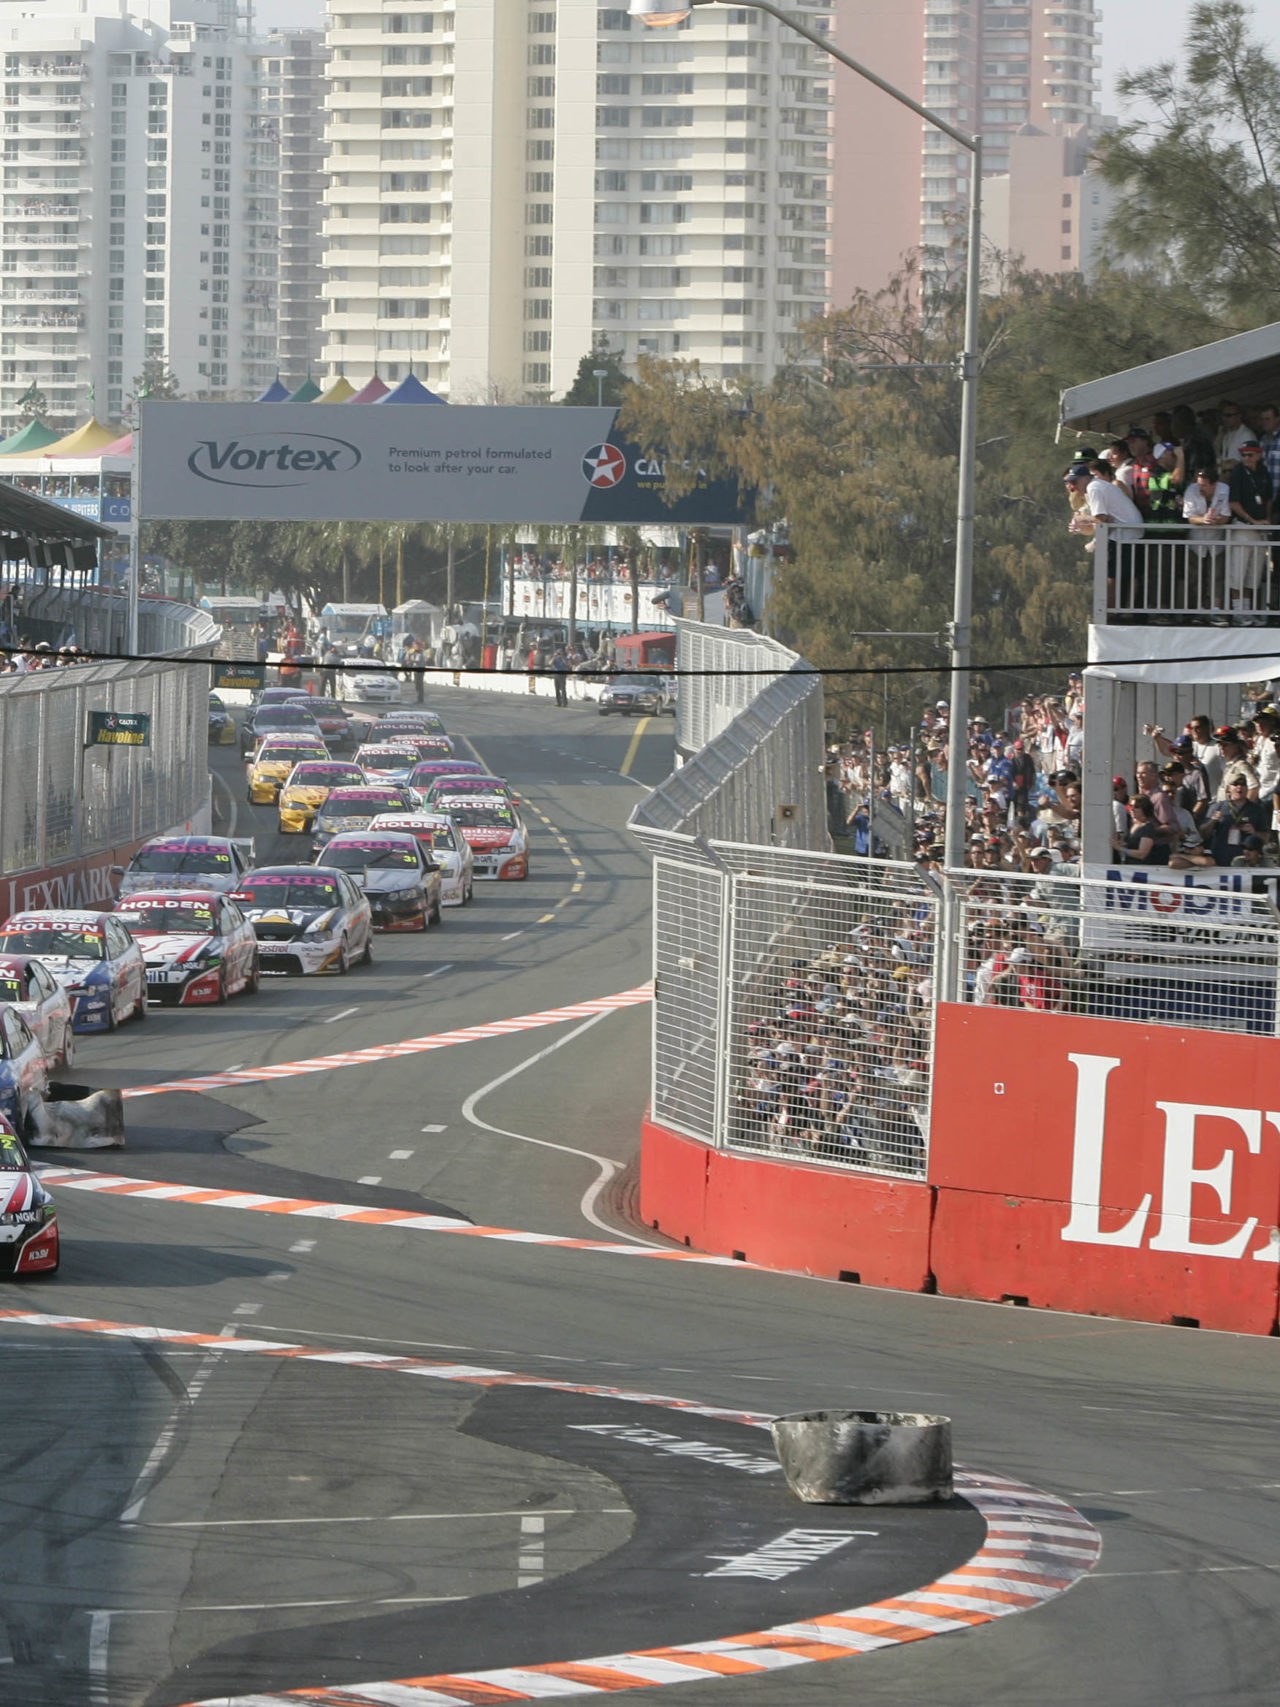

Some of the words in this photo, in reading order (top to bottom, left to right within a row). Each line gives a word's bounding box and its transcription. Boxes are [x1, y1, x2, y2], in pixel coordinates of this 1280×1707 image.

[197, 441, 342, 471] Vortex
[388, 447, 441, 458] Premium
[445, 448, 482, 460] petrol
[486, 448, 552, 459] formulated
[388, 462, 401, 473] to
[404, 462, 430, 473] look
[434, 462, 462, 474] after
[467, 464, 494, 476] your
[498, 464, 519, 475] car.
[97, 728, 145, 745] Havoline
[438, 802, 507, 810] HOLDEN
[374, 821, 449, 831] HOLDEN
[144, 844, 227, 853] FORD
[332, 841, 409, 849] FORD
[215, 854, 229, 862] 10
[402, 855, 417, 864] 31
[248, 876, 330, 885] FORD
[9, 865, 116, 916] LEXMARK
[1105, 870, 1242, 915] Mobil
[120, 900, 210, 911] HOLDEN
[194, 910, 212, 919] 22
[243, 908, 312, 927] CAT
[5, 922, 99, 933] HOLDEN
[5, 981, 18, 989] 11
[1, 1139, 13, 1150] 2
[15, 1211, 37, 1222] NGK
